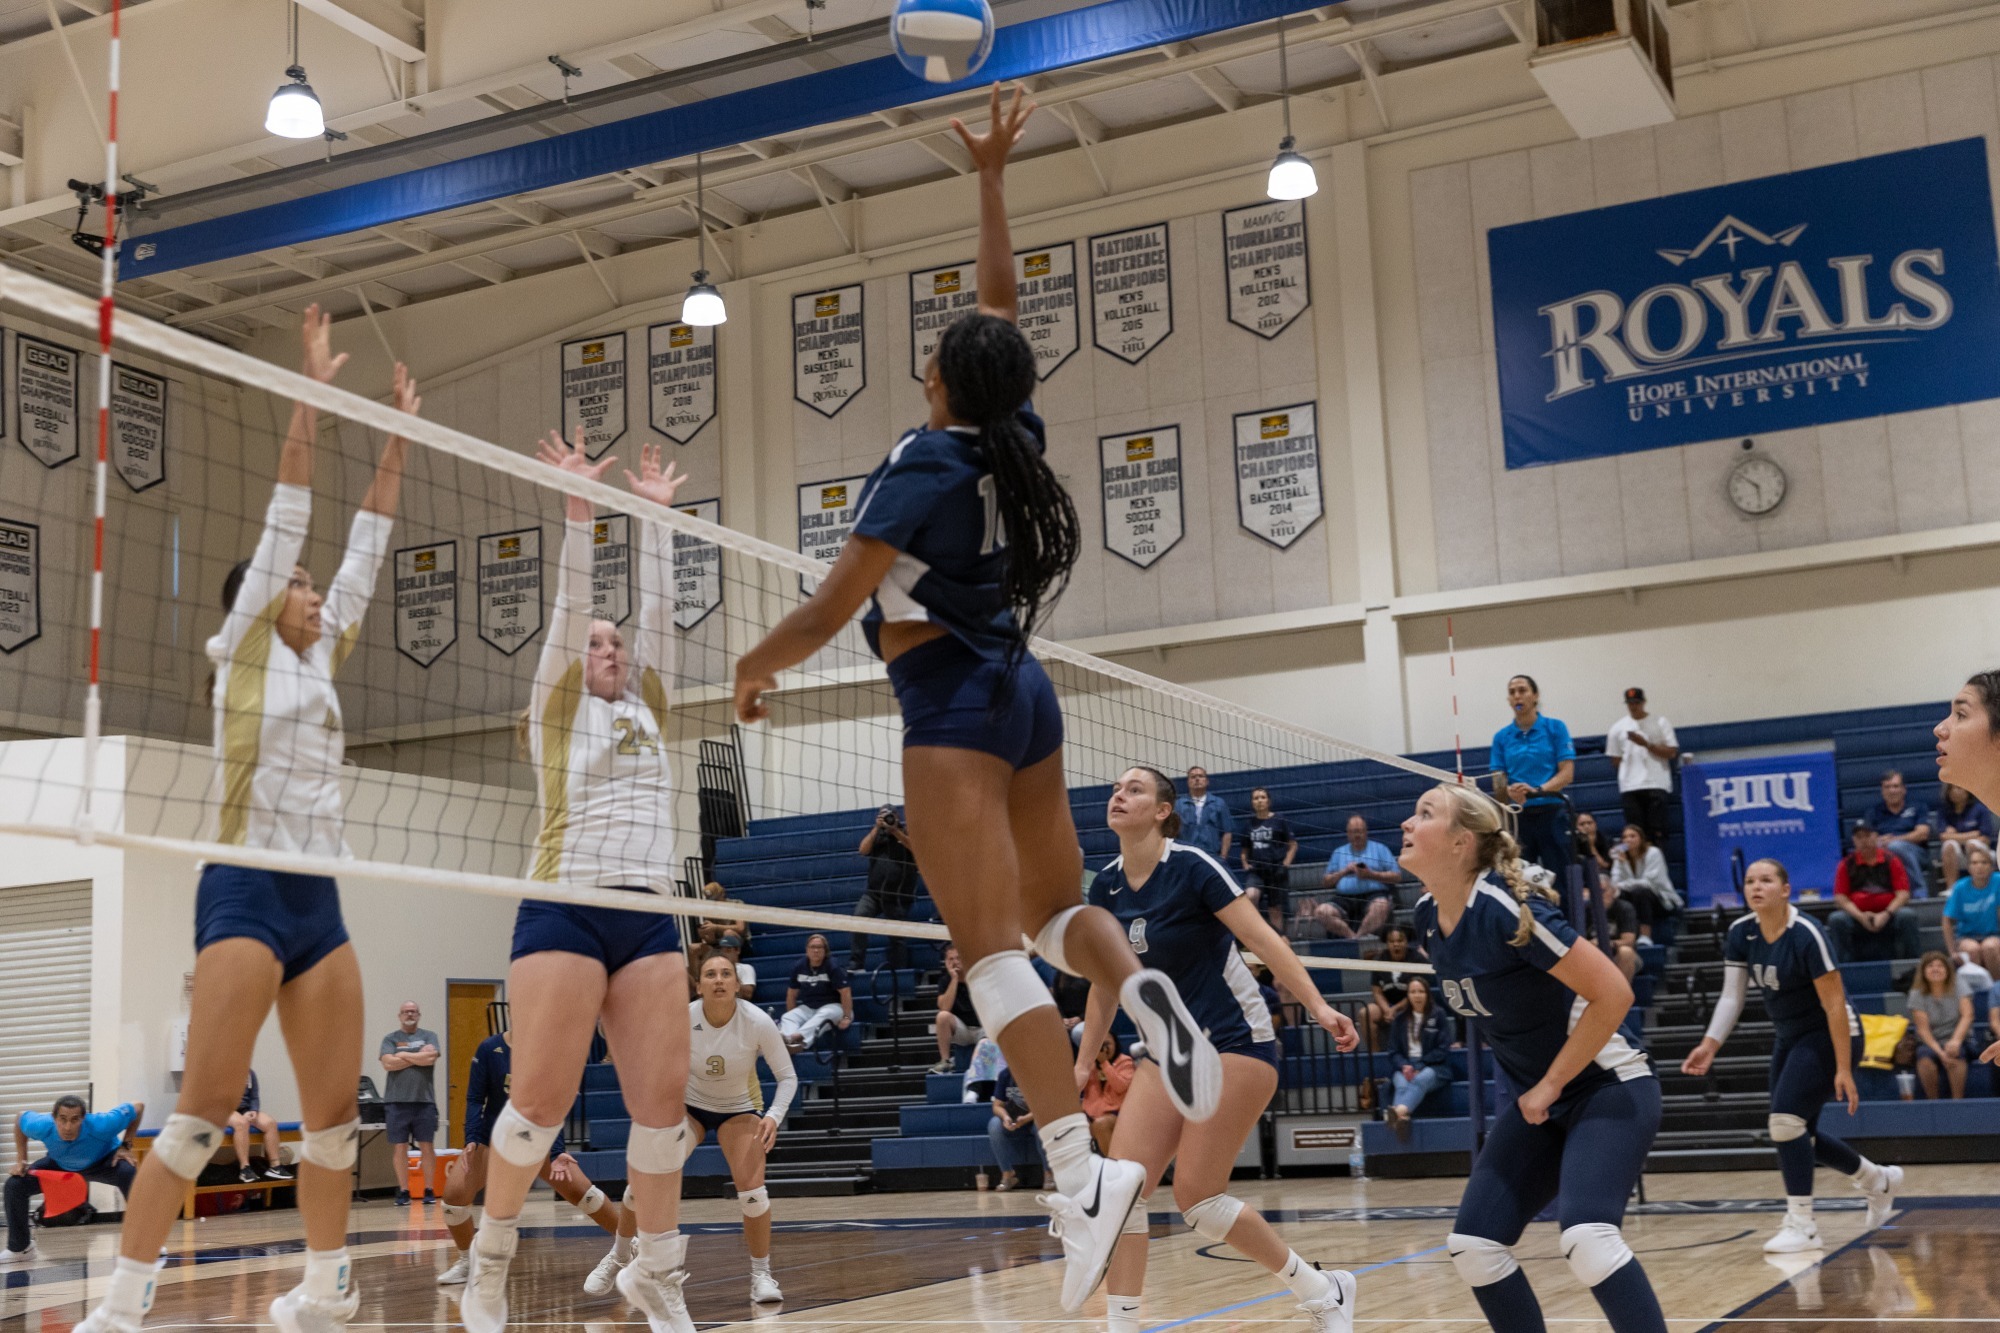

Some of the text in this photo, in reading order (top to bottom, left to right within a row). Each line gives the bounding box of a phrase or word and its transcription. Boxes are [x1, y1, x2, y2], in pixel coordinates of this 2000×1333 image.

[1097, 232, 1160, 258] NATIONAL
[1229, 222, 1301, 251] TOURNAMENT
[1095, 249, 1165, 276] CONFERENCE
[1230, 242, 1303, 270] CHAMPIONS
[1025, 261, 1049, 273] GSAC
[1254, 264, 1281, 279] MEN'S
[935, 279, 959, 289] GSAC
[1043, 273, 1073, 291] SEASON
[1096, 268, 1165, 295] CHAMPIONS
[1240, 276, 1297, 296] VOLLEYBALL
[914, 290, 977, 315] REGULAR SEASO
[1018, 292, 1073, 316] AMPIONS
[1119, 290, 1143, 304] MEN'S
[1258, 293, 1280, 307] 2012
[1104, 302, 1160, 320] VOLLEYBALL
[797, 313, 860, 337] REGULAR SEASON
[1019, 313, 1060, 329] SOFTBALL
[1122, 318, 1143, 332] 2015
[1539, 248, 1953, 401] ROYALS
[670, 334, 692, 342] GSAC
[798, 329, 859, 352] CHAMPIONS
[1031, 328, 1050, 341] 2021
[583, 350, 604, 359] GSAC
[818, 348, 839, 360] MEN'S
[1122, 341, 1145, 353] HIU
[29, 349, 68, 371] GSAC
[651, 345, 712, 368] REGULAR SEASON
[564, 360, 624, 382] TOURNAMENT
[653, 362, 713, 385] CHAMPIONS
[804, 358, 853, 375] BASKETBALL
[120, 374, 158, 399] GSAC
[565, 375, 623, 398] CHAMPIONS
[820, 372, 838, 384] 2017
[1627, 352, 1868, 406] HOPE INTERNATIONAL
[21, 385, 72, 408] CHAMPIONS
[663, 381, 701, 396] SOFTBALL
[813, 389, 848, 403] ROYALS
[1629, 372, 1869, 423] UNIVERSITY
[579, 394, 609, 407] WOMEN'S
[23, 402, 69, 424] BASEBALL
[113, 403, 162, 426] CHAMPIONS
[580, 404, 608, 418] SOCCER
[34, 419, 58, 434] 2022
[118, 420, 157, 439] WOMEN'S
[665, 414, 701, 427] ROYALS
[1262, 423, 1288, 433] GSAC
[121, 433, 155, 451] SOCCER
[1127, 446, 1153, 456] GSAC
[1239, 434, 1314, 461] TOURNAMENT
[128, 447, 149, 461] 2021
[1105, 458, 1176, 483] REGULAR SEASON
[1241, 453, 1316, 479] CHAMPIONS
[1106, 476, 1178, 500] CHAMPIONS
[1259, 473, 1298, 490] WOMEN'S
[822, 495, 846, 503] GSAC
[1130, 496, 1155, 510] MEN'S
[1250, 485, 1309, 505] BASKETBALL
[1126, 509, 1161, 524] SOCCER
[1270, 502, 1292, 516] 2014
[802, 512, 833, 529] REGULAR
[1133, 523, 1154, 536] 2014
[0, 531, 30, 549] SAC
[1270, 526, 1296, 538] HIU
[0, 552, 30, 565] FERENCE
[1133, 545, 1156, 556] HIU
[0, 562, 31, 576] MPIONS
[480, 559, 539, 579] TOURNAMENT
[673, 566, 706, 580] OFTBALL
[397, 570, 456, 591] REGULAR SEASON
[481, 575, 538, 595] CHAMPIONS
[593, 580, 615, 592] TBALL
[397, 587, 454, 608] CHAMPIONS
[492, 593, 527, 607] BASEBALL
[593, 594, 606, 605] 019
[408, 605, 442, 619] BASEBALL
[493, 626, 526, 639] ROYALS
[410, 638, 441, 651] ROYALS
[613, 717, 660, 756] 24
[1703, 771, 1814, 817] HIU
[1129, 917, 1149, 954] 9
[1753, 963, 1780, 991] 14
[1442, 977, 1493, 1017] 21
[706, 1055, 726, 1076] 3
